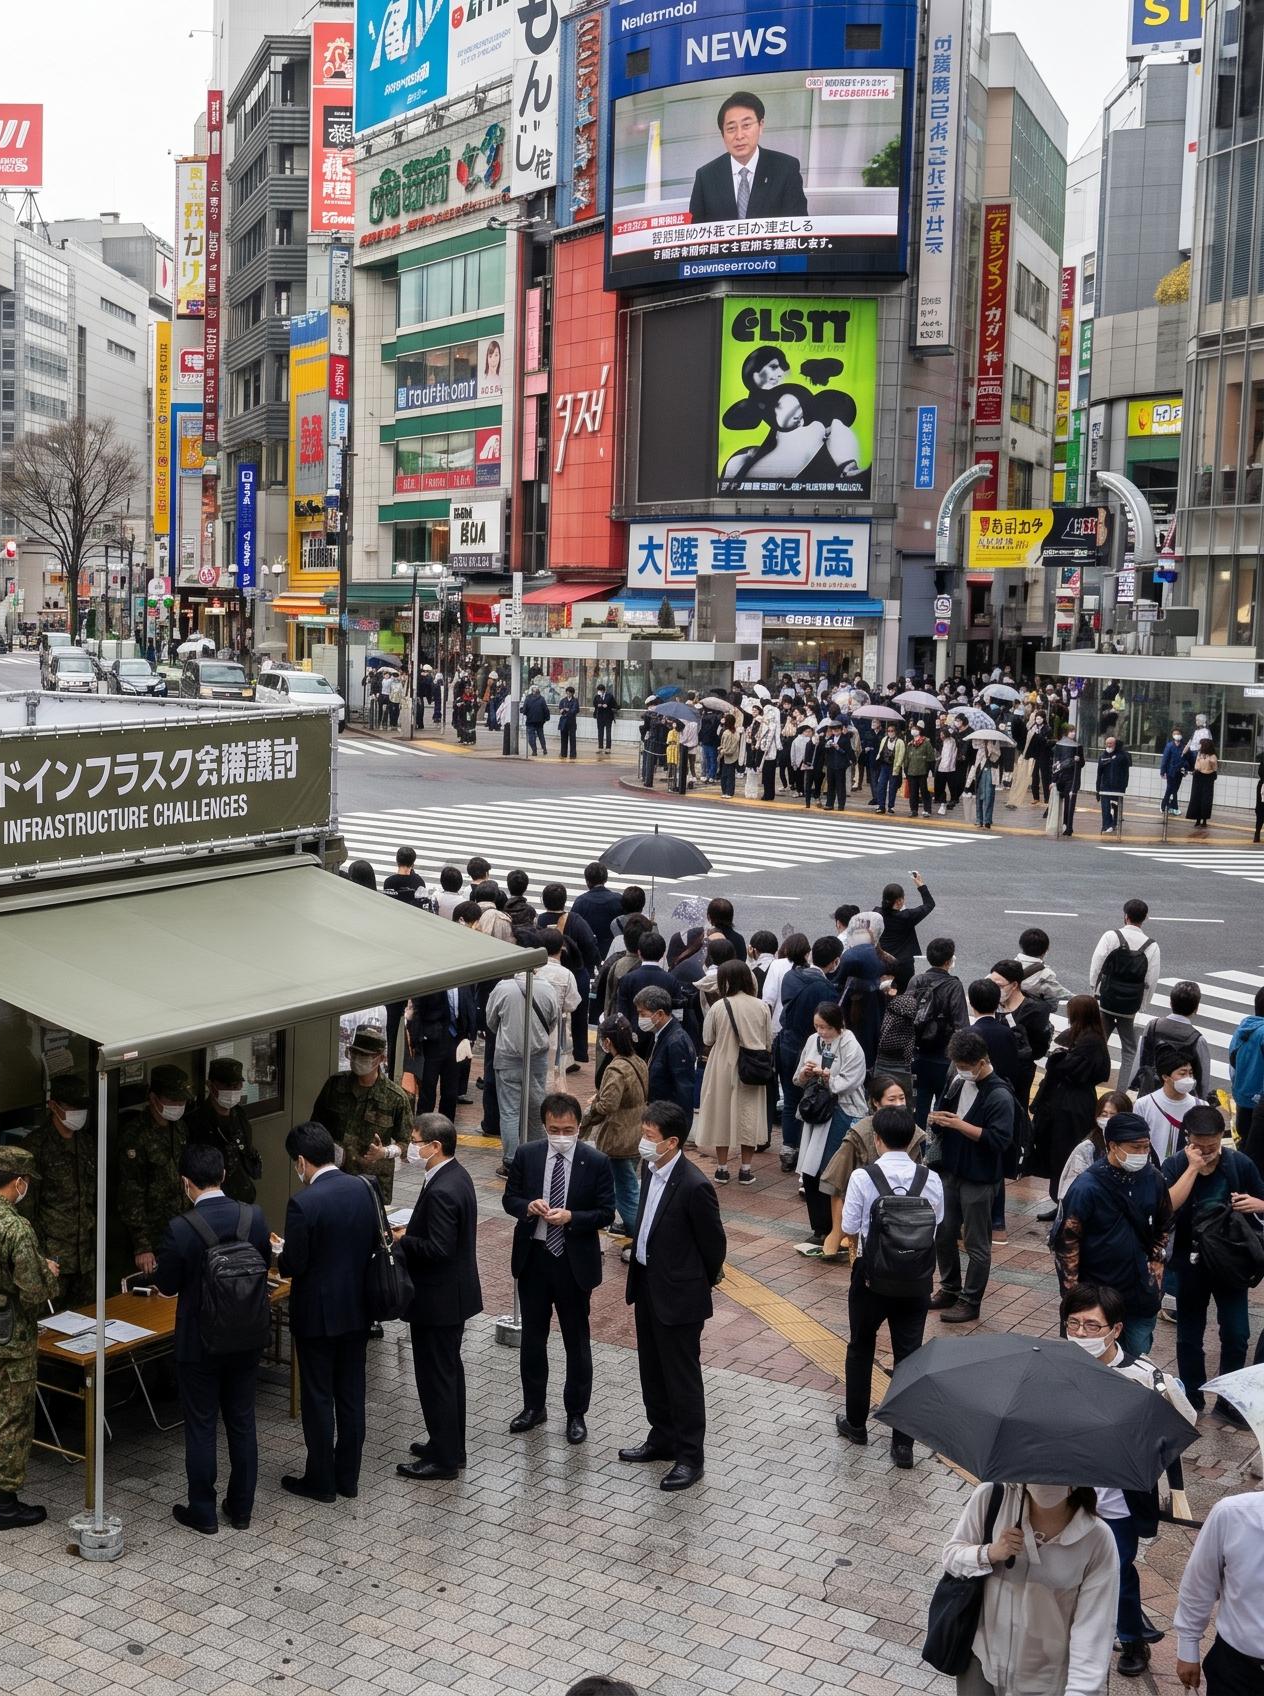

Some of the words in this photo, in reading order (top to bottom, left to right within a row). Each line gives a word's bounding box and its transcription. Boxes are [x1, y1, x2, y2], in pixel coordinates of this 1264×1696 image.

[686, 26, 787, 66] NEWS
[3, 804, 149, 845] INFRASTRUCTURE
[153, 793, 248, 827] CHALLENGES
